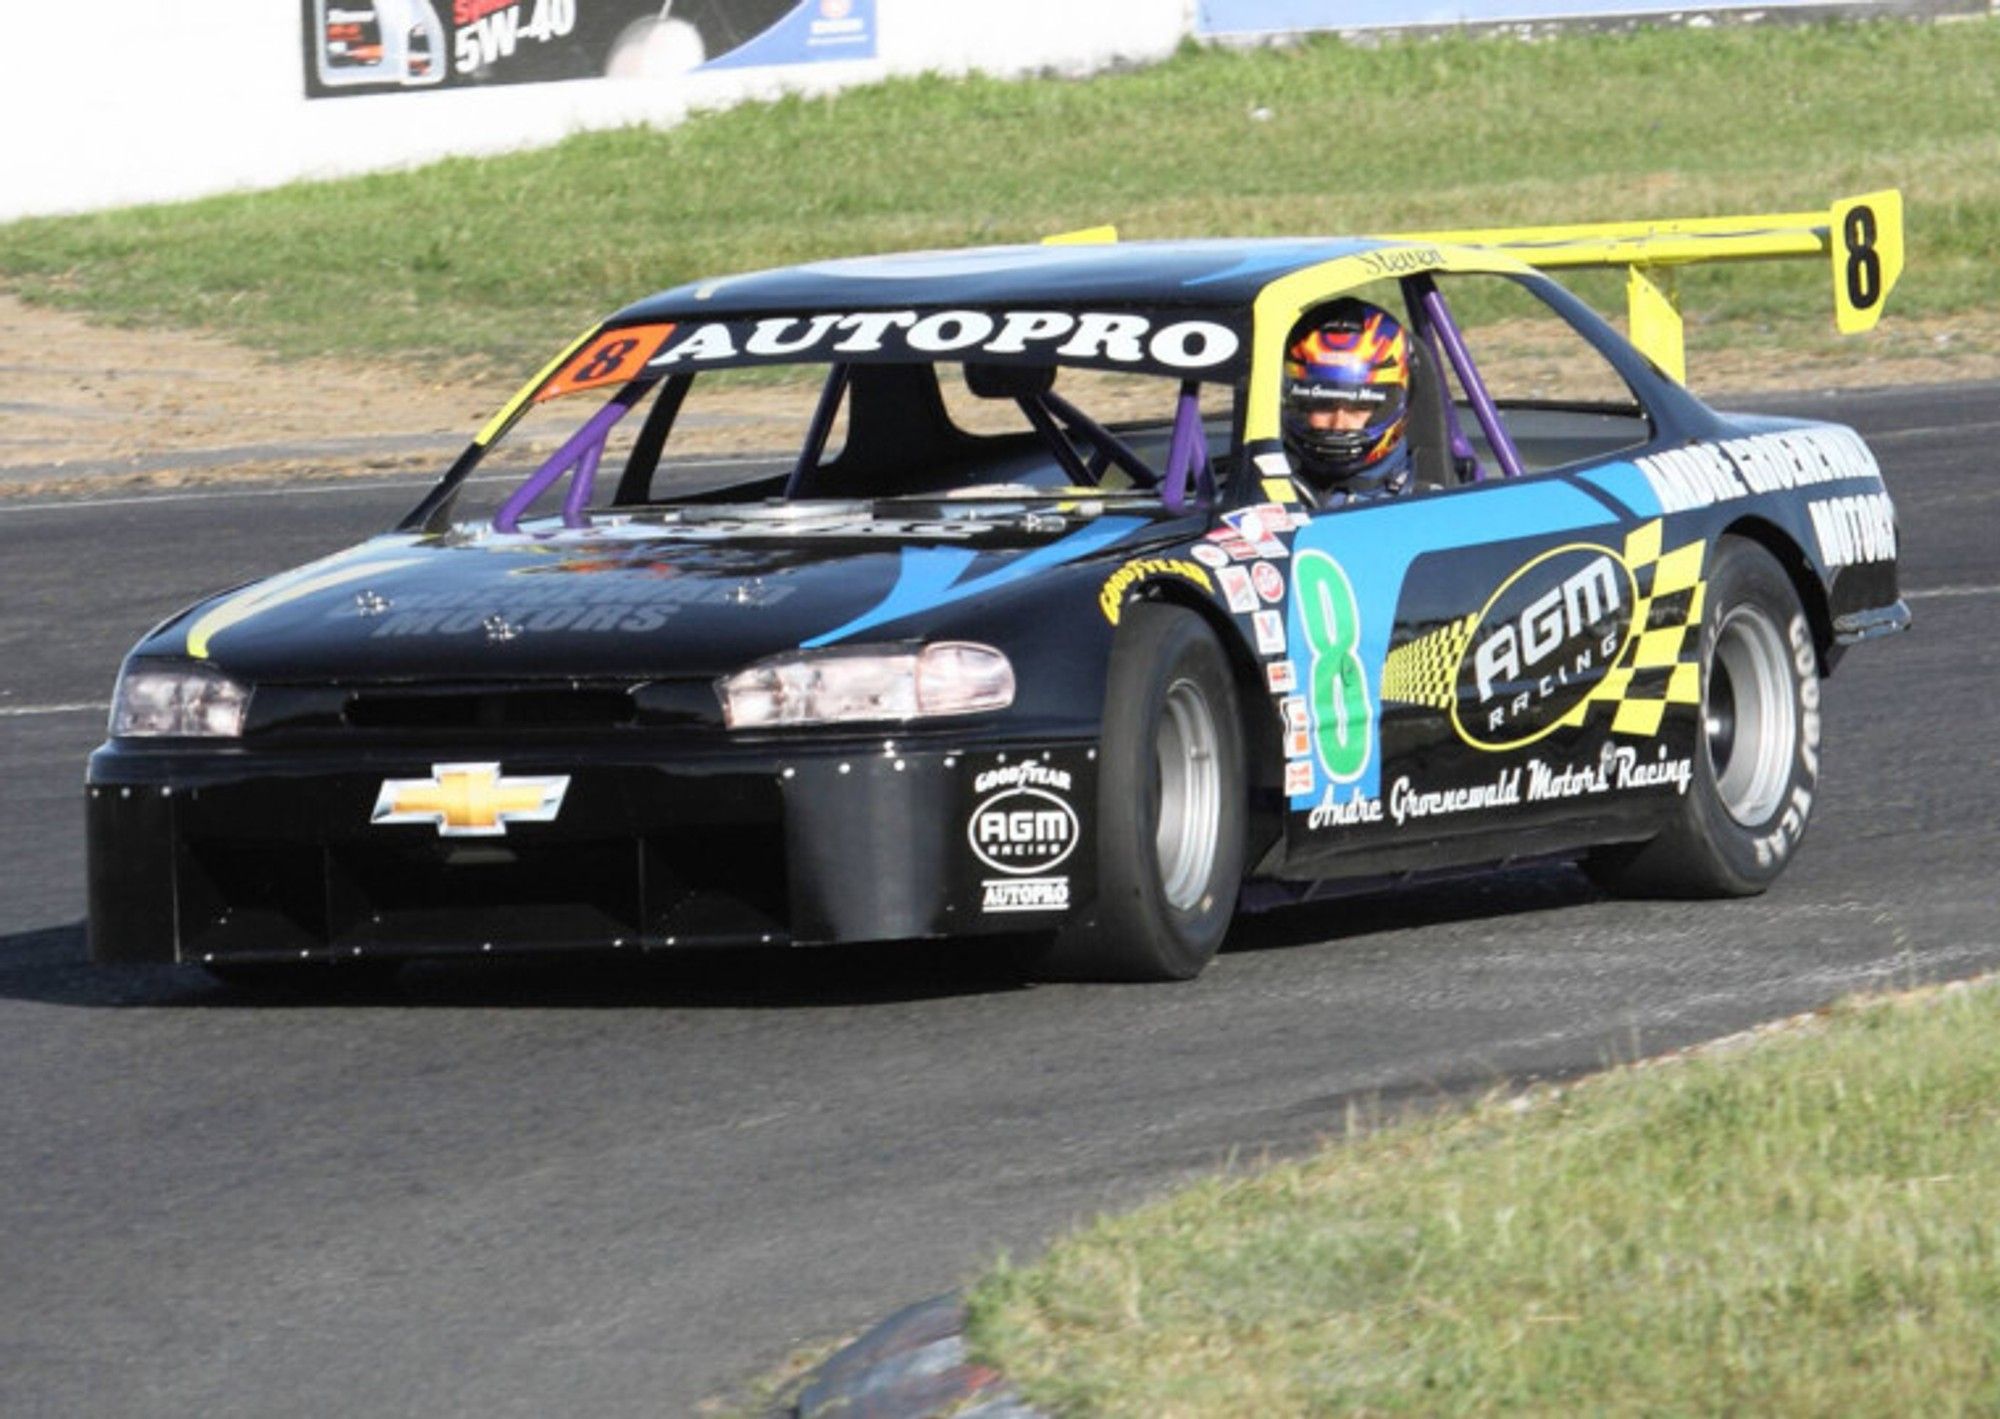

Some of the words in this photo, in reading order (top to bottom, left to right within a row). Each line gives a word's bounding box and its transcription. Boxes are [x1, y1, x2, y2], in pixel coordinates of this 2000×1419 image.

[1844, 205, 1880, 310] 8
[573, 338, 639, 382] 8
[651, 310, 1239, 368] AUTOPRO
[1475, 556, 1621, 703] AGM
[1292, 549, 1373, 784] 8
[1489, 629, 1618, 732] RACING
[974, 760, 1071, 793] GOODYEAR
[1308, 783, 1384, 830] Andre
[1390, 768, 1521, 826] Groenewald
[1616, 745, 1693, 795] Racing
[980, 811, 1069, 843] AGM
[988, 843, 1061, 856] RACING
[983, 882, 1069, 905] AUTOPRO
